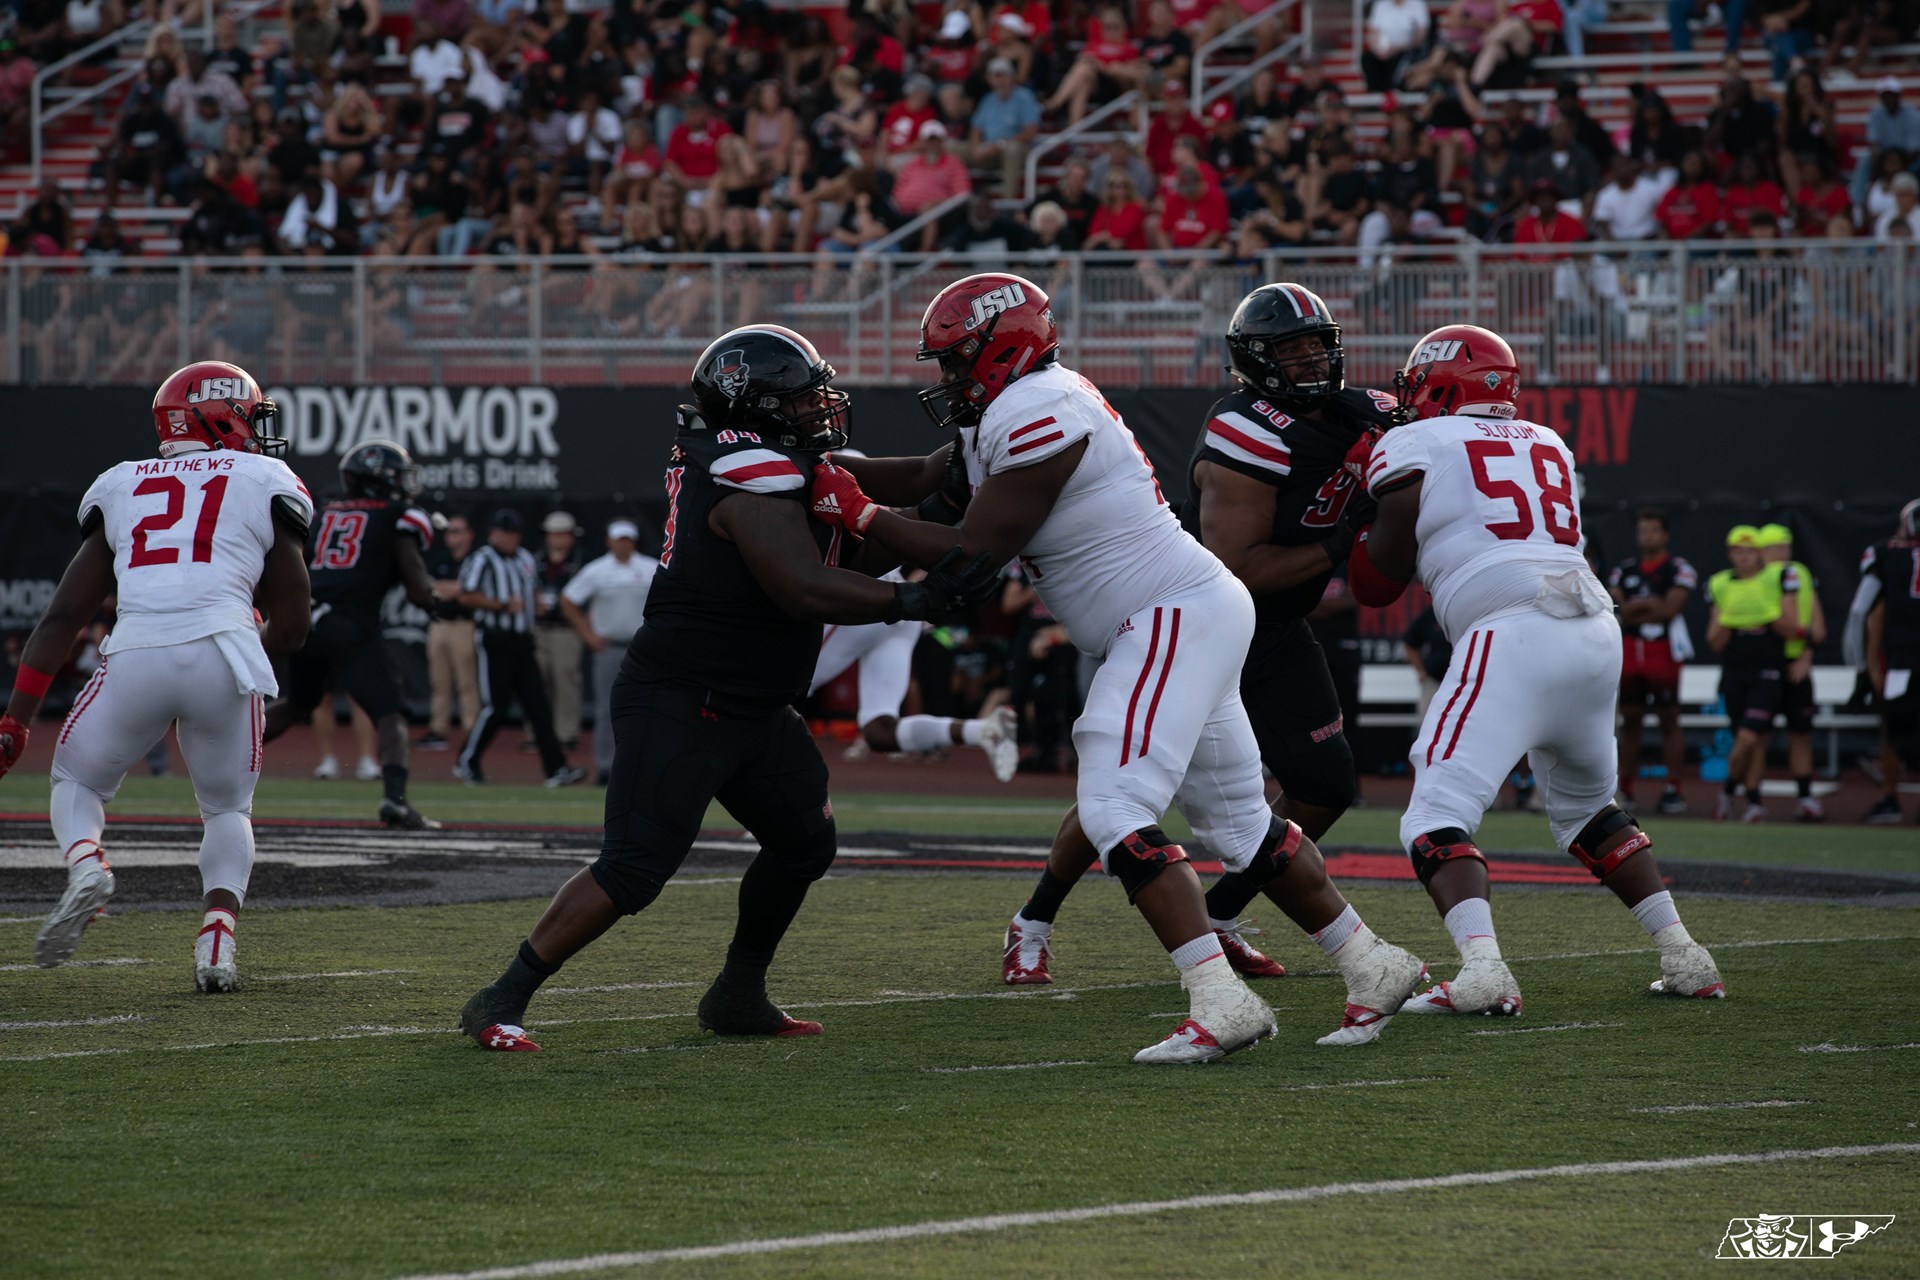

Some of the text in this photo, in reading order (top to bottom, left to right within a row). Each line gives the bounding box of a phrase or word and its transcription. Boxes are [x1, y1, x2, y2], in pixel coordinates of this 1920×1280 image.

[963, 282, 1027, 331] JSU
[187, 377, 250, 404] JSU
[266, 386, 560, 457] ODYARMOR
[717, 428, 762, 444] 44
[1474, 422, 1540, 440] SLOCUM
[135, 458, 235, 476] MATTHEWS
[484, 459, 559, 489] Drink
[1464, 439, 1580, 547] 58
[128, 474, 229, 569] 21
[813, 503, 843, 515] adidas
[310, 510, 369, 571] 13
